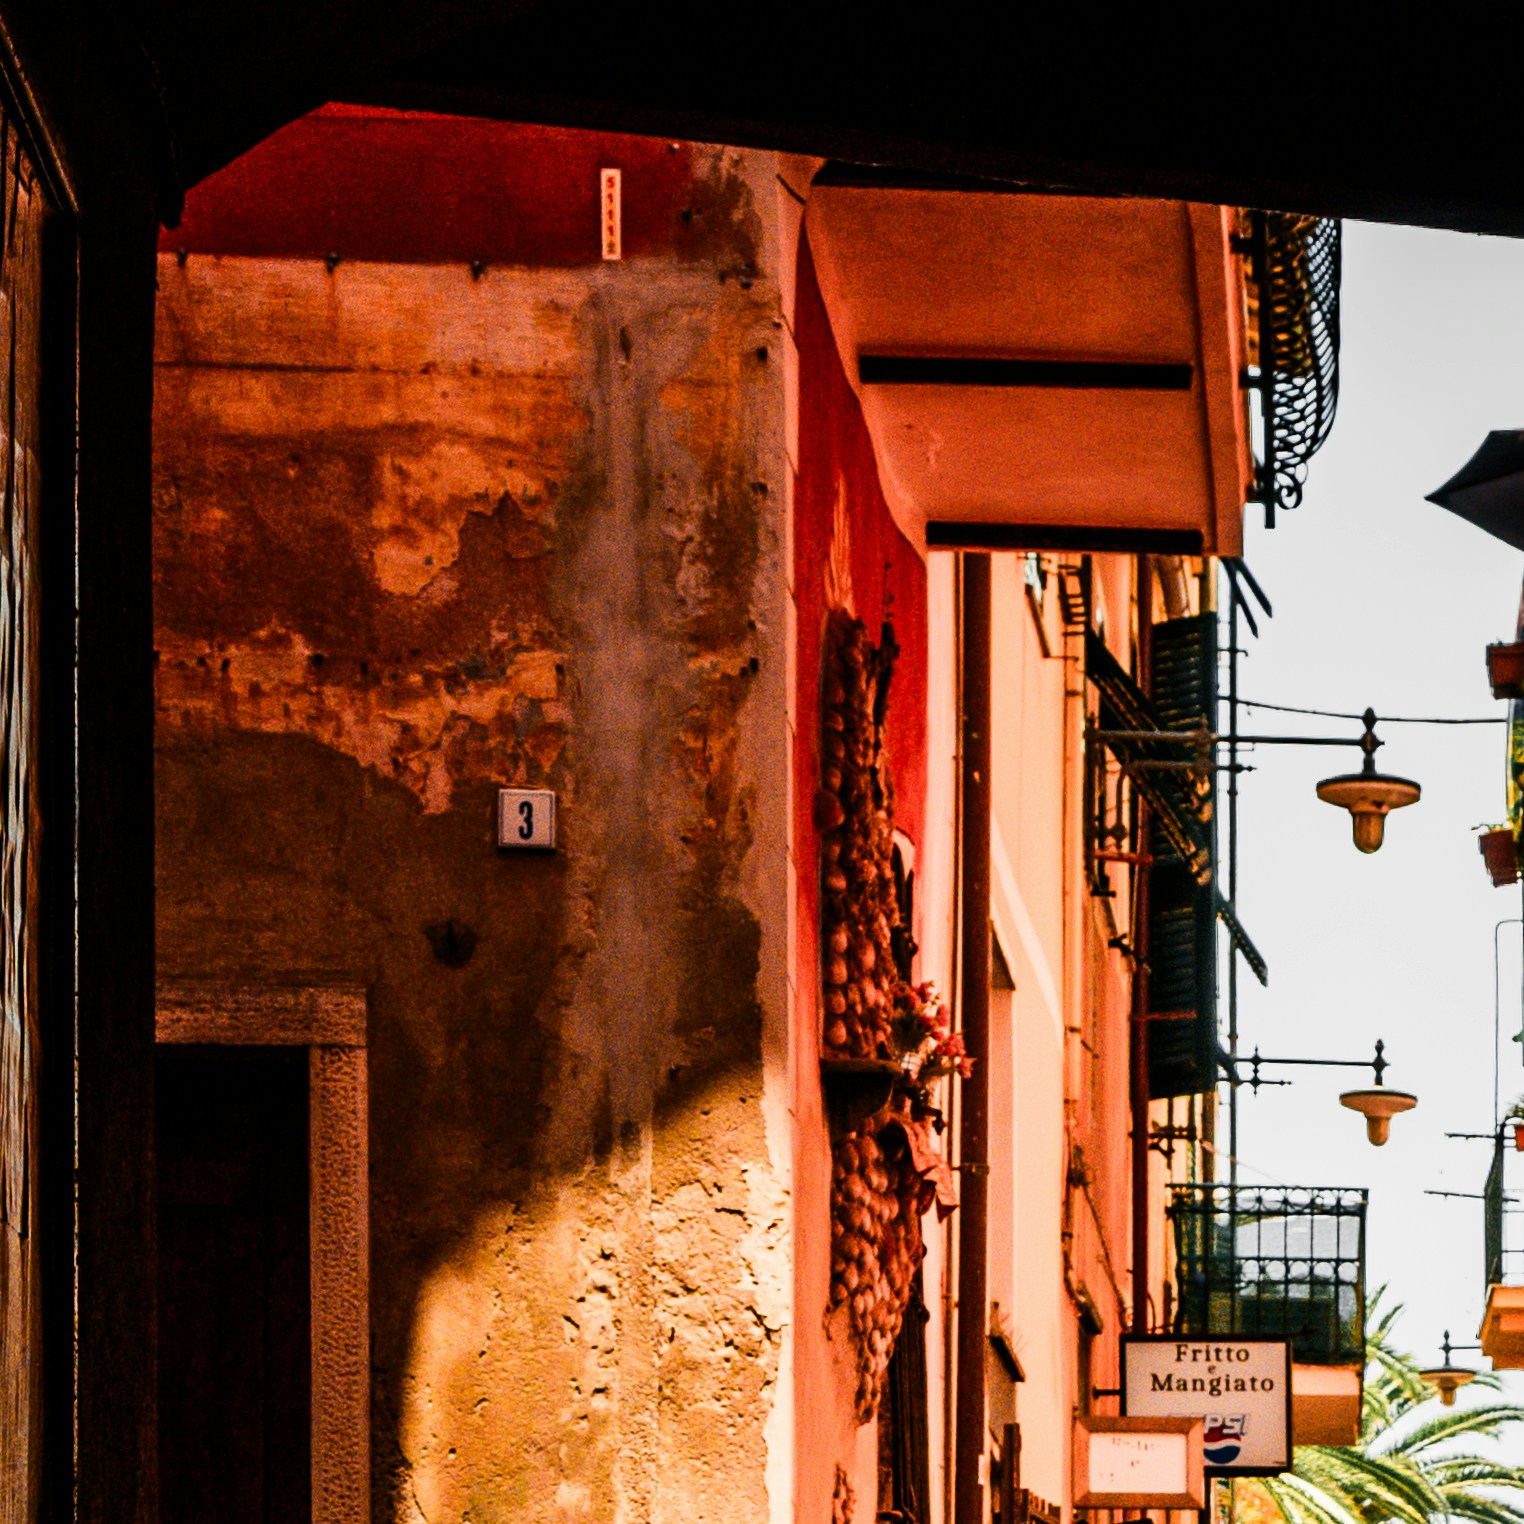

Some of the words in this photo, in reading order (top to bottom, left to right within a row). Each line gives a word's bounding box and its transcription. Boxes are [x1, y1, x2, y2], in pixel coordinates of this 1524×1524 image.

[518, 800, 533, 840] 3
[1174, 1343, 1250, 1362] Fritto
[1207, 1365, 1217, 1374] e
[1150, 1372, 1274, 1397] Mangiato
